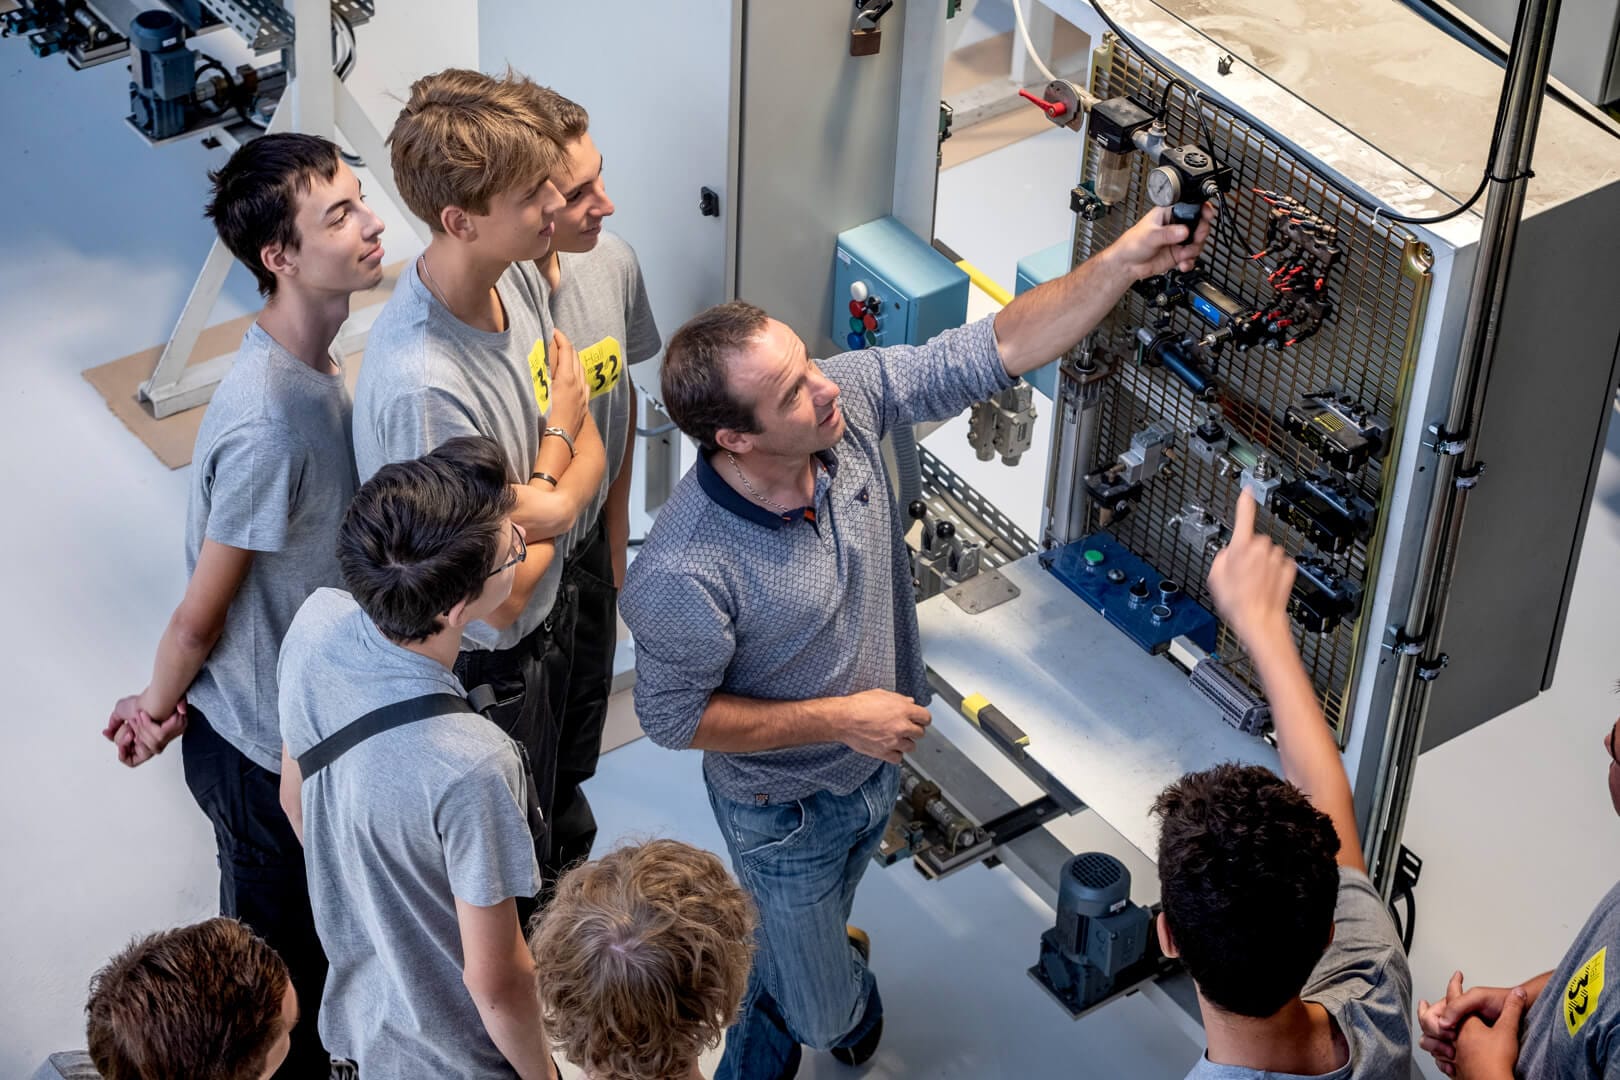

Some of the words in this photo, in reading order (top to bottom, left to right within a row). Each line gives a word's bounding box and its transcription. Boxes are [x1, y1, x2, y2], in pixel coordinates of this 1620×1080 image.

[535, 367, 549, 400] 3
[589, 355, 618, 391] 32
[1567, 967, 1590, 1027] 32
